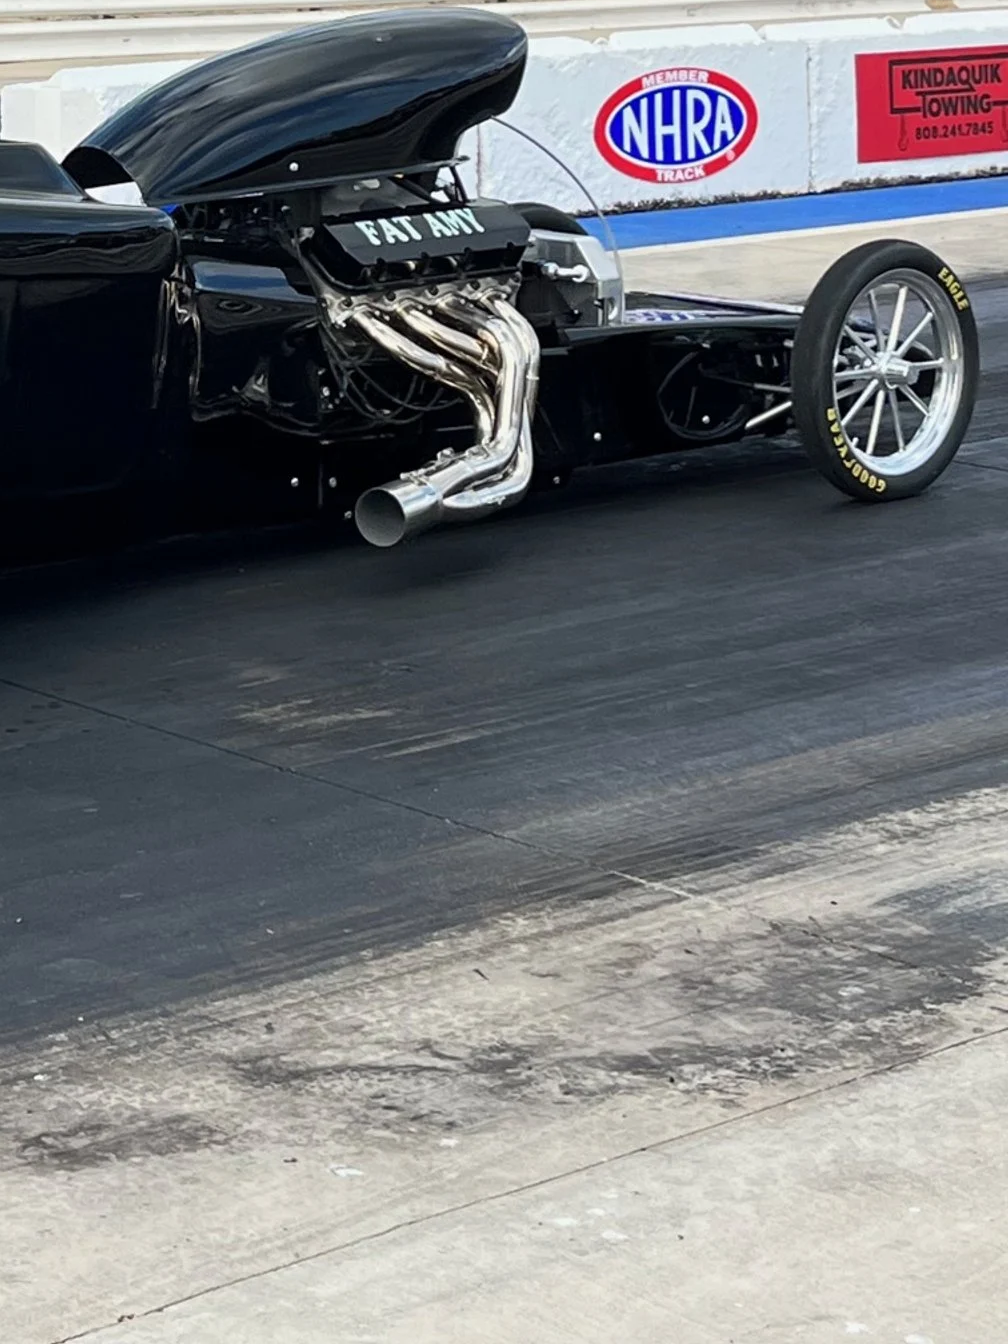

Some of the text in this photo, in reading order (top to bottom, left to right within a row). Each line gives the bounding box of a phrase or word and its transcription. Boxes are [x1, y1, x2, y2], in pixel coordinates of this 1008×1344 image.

[642, 69, 709, 89] MEMBER
[901, 63, 1003, 91] KINDAQUIK
[916, 91, 992, 119] TOWING
[622, 89, 736, 161] NHRA
[915, 121, 995, 141] 808.241.7845
[655, 165, 706, 182] TRACK
[355, 207, 486, 246] FAT AMY
[938, 267, 969, 311] EAGLE
[827, 408, 887, 493] GOODYEAR
